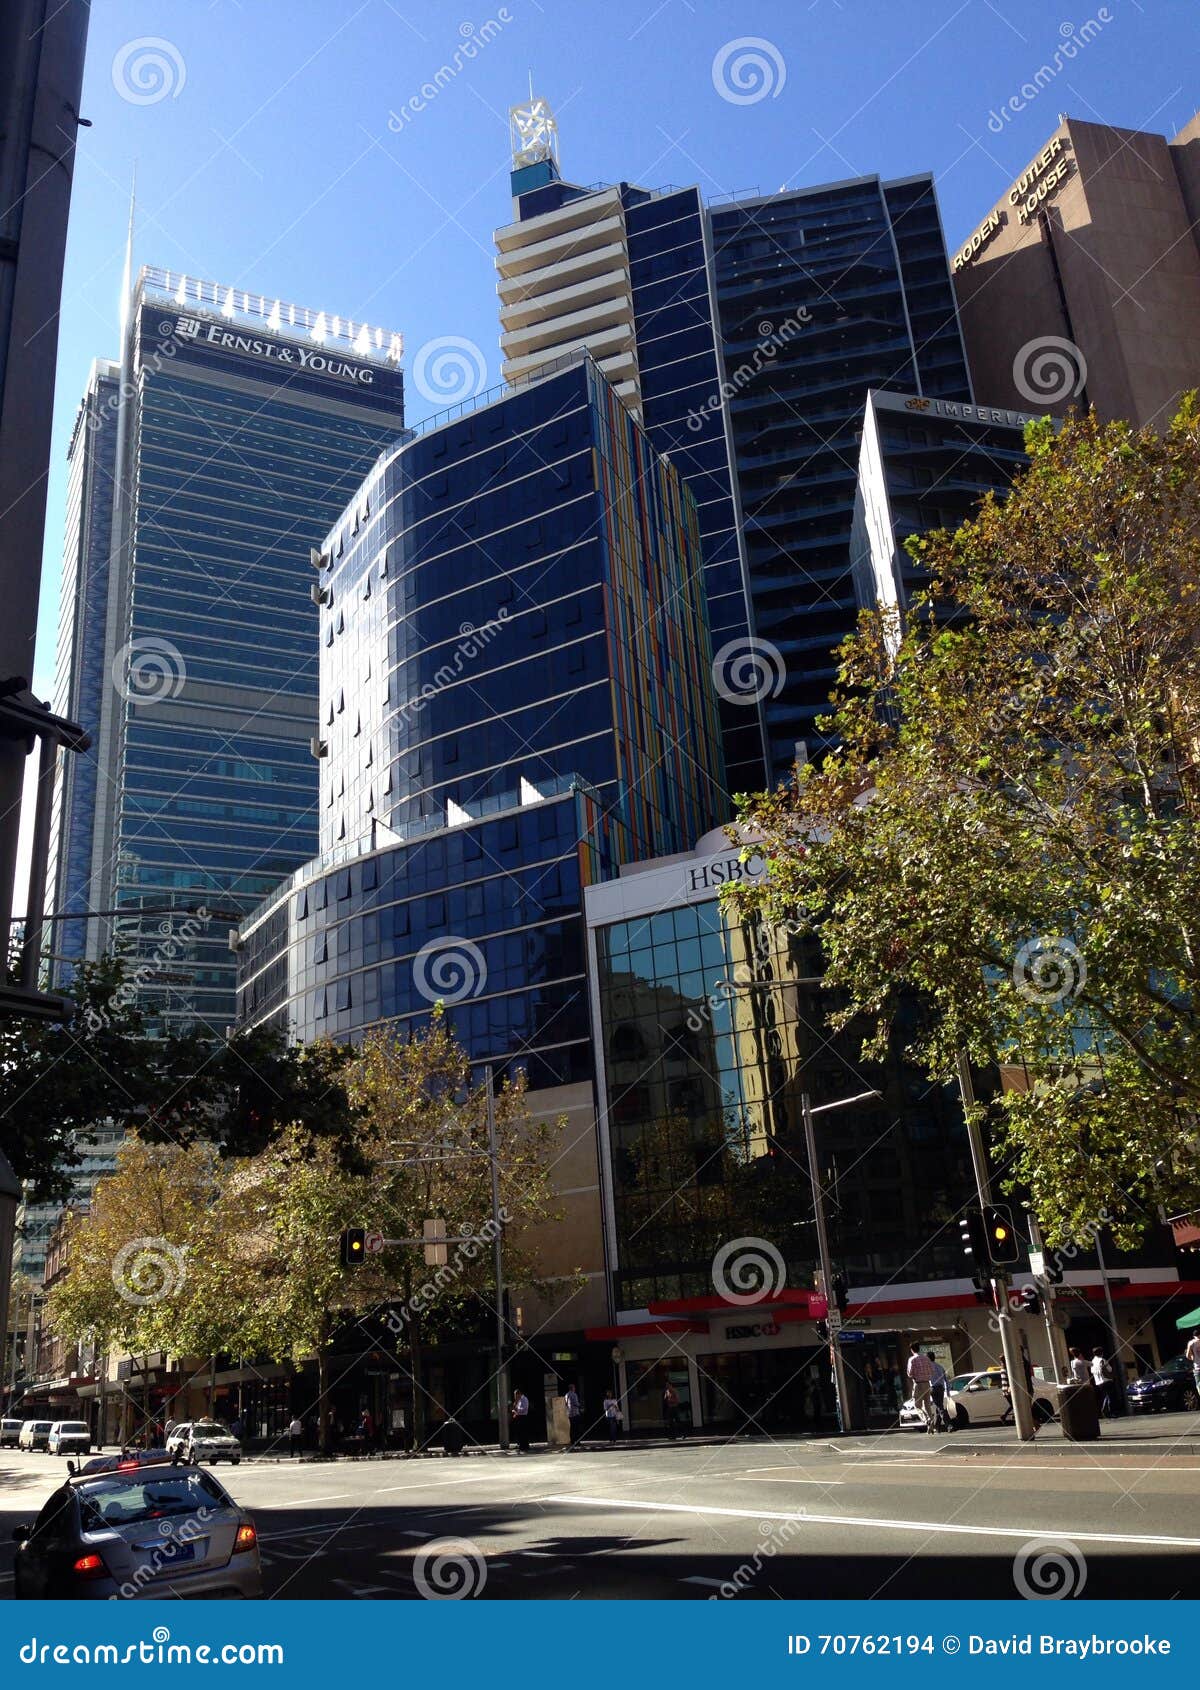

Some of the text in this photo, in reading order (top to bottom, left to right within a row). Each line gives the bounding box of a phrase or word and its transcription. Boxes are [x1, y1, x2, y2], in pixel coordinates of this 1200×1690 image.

[953, 136, 1062, 269] RODEN CUTLER
[1017, 158, 1068, 225] HOUSE
[206, 324, 374, 383] ERNST & YOUNG
[936, 401, 1026, 425] IMPERIA
[689, 854, 763, 891] HSBC
[116, 1452, 140, 1463] TAXI
